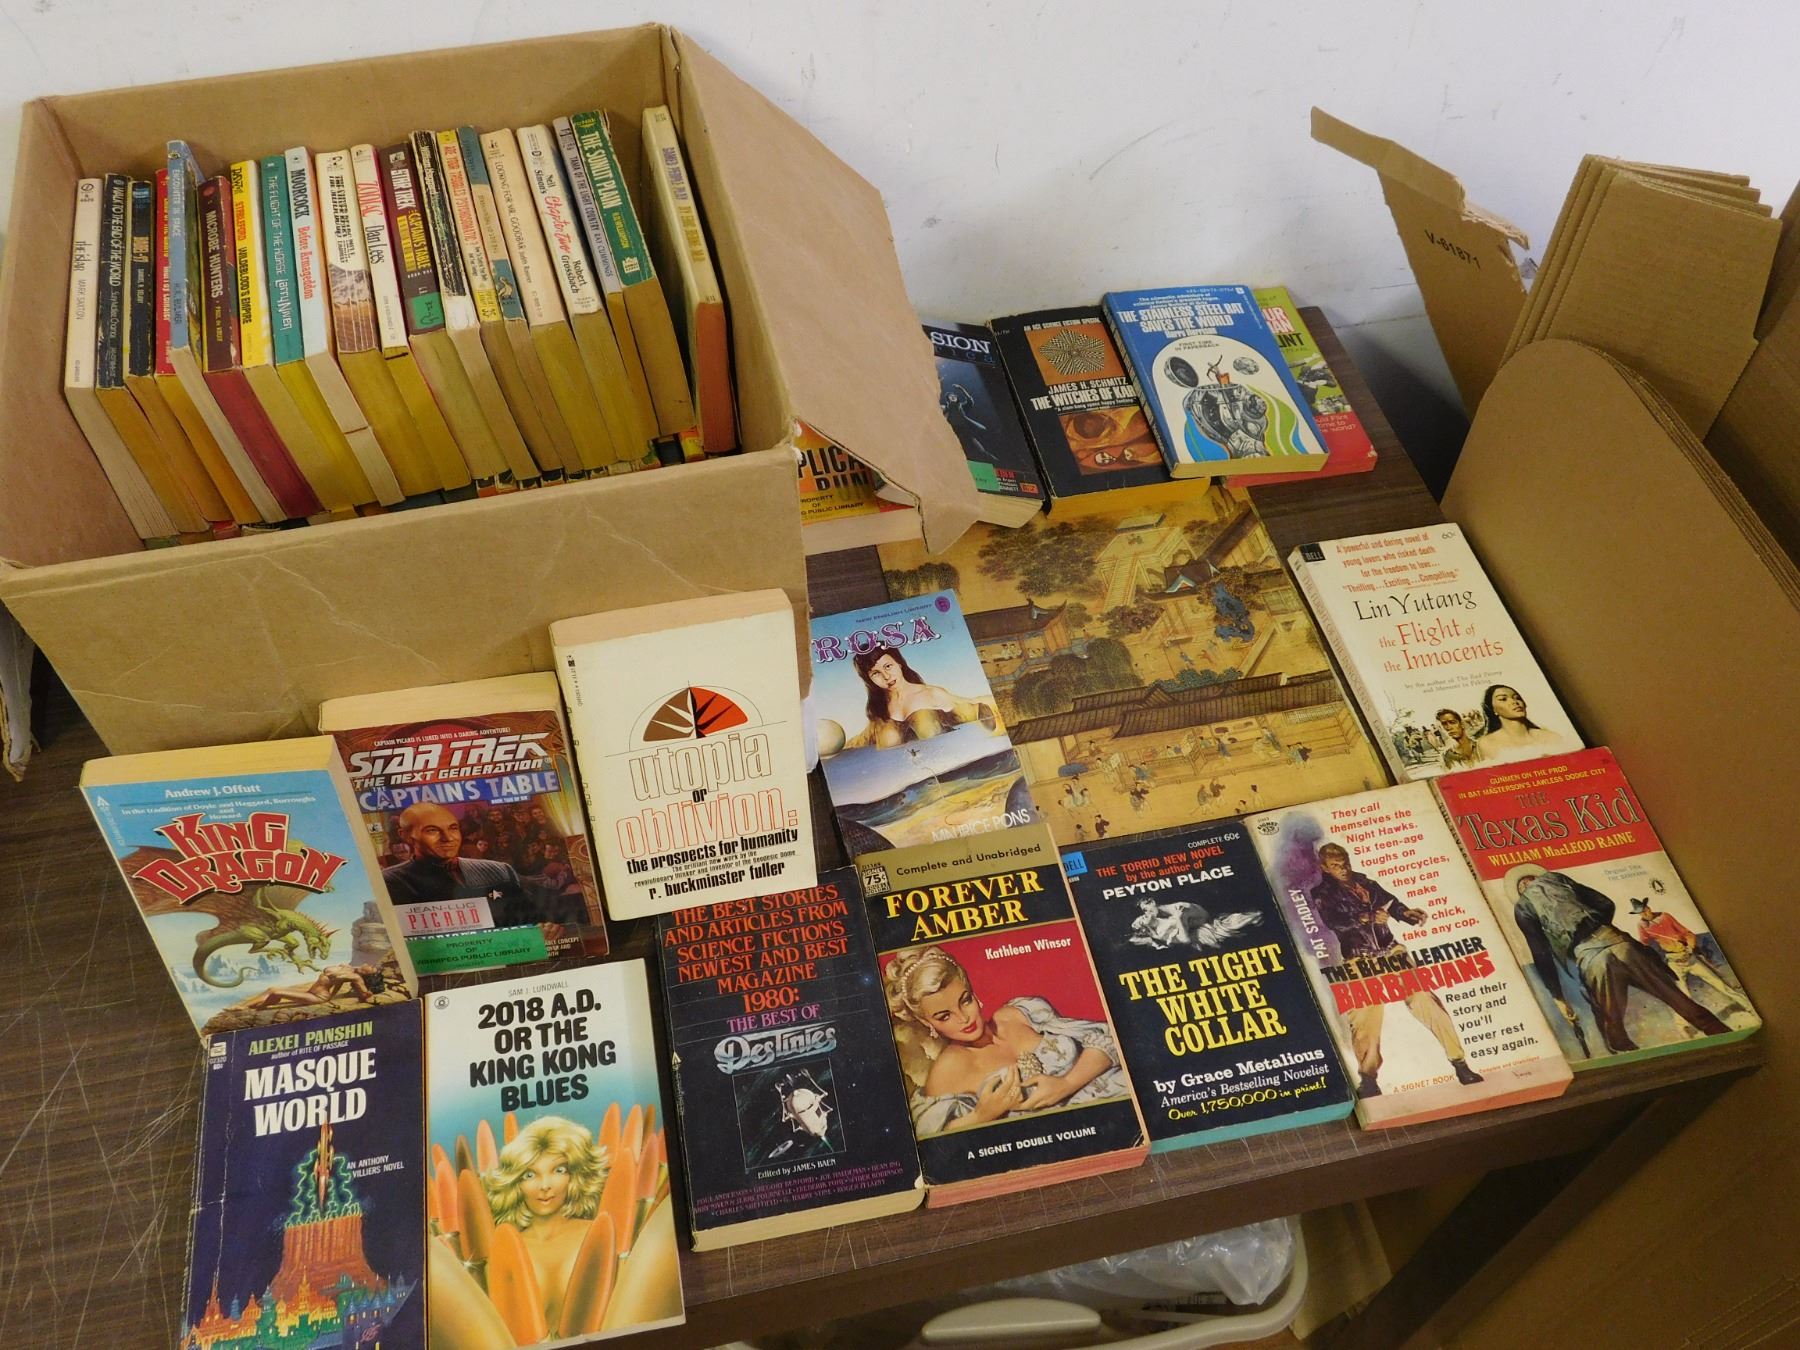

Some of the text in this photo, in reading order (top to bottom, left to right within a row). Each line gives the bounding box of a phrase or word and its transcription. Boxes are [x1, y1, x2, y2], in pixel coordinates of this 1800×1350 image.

[580, 130, 602, 151] THE
[585, 147, 613, 182] SUNLIT
[289, 168, 309, 218] MOORCOCK
[356, 180, 383, 218] ZODIAC
[595, 178, 622, 210] PLAIN
[267, 175, 285, 274] THE FLIGHT OF THE HORSE
[364, 224, 389, 264] Dan Lees
[204, 210, 222, 297] MICROBE HUNTERS
[297, 226, 315, 300] Before Armageddon
[572, 259, 587, 286] Robert
[560, 254, 580, 294] Grossbach
[1117, 303, 1244, 323] THE STAINLESS STEEL RAT
[1140, 315, 1234, 333] SAVES THE WORLD
[1030, 398, 1053, 411] THE
[1052, 390, 1099, 406] WITCHES
[1100, 388, 1114, 401] OF
[1048, 377, 1128, 395] JAMES H. SCHMITZ
[1353, 590, 1477, 621] Lin Yutang
[811, 616, 941, 664] ROSA
[1380, 618, 1476, 649] the Flight of
[1384, 639, 1504, 673] the Innocents
[350, 732, 550, 777] STAR TREK
[354, 759, 543, 788] THE NEXT GENERATION
[629, 733, 772, 802] utopia
[164, 783, 262, 799] Andrew J. Offutt
[358, 770, 559, 811] CAPTAIN'S TABLE
[692, 788, 708, 803] or
[616, 787, 799, 860] oblivion:
[932, 808, 1031, 842] MAURICE PONS
[1329, 808, 1412, 834] themselves the
[1331, 802, 1381, 821] They call
[1456, 787, 1643, 851] Texas Kid
[153, 812, 290, 859] KING
[627, 828, 798, 875] the prospects for humanity
[1346, 823, 1419, 844] Night Hawks.
[1488, 831, 1636, 868] WILLIAM MacLEOD RAINE
[131, 846, 349, 905] DRAGON
[896, 843, 1042, 877] Complete and Unabridged
[649, 861, 785, 900] r. buckminster fuller
[883, 870, 1044, 919] FOREVER
[1102, 865, 1235, 901] PEYTON PLACE
[407, 909, 480, 930] PICARD
[664, 901, 849, 948] AND ARTICLES FROM
[671, 884, 839, 927] THE BEST STORIES
[911, 899, 1029, 942] AMBER
[1288, 888, 1329, 961] PAT STADLEY
[677, 920, 846, 964] SCIENCE FICTION'S
[677, 937, 849, 983] NEWEST AND BEST
[985, 937, 1072, 961] Kathleen Winsor
[1320, 936, 1487, 984] THE BLACK LEATHER
[716, 962, 817, 995] MAGAZINE
[1118, 943, 1285, 1002] THE TIGHT
[1328, 949, 1496, 1016] BARBARIANS
[477, 989, 602, 1029] 2018 A.D.
[726, 1004, 820, 1033] THE BEST OF
[743, 986, 800, 1014] 1980:
[1156, 979, 1268, 1025] WHITE
[249, 1021, 373, 1056] ALEXEI PANSHIN
[494, 1016, 589, 1055] OR THE
[713, 1020, 838, 1075] Destinies
[1164, 1007, 1287, 1057] COLLAR
[244, 1047, 377, 1101] MASQUE
[470, 1040, 617, 1088] KING KONG
[1153, 1049, 1325, 1095] by Grace Metalious
[254, 1087, 367, 1137] WORLD
[500, 1074, 589, 1113] BLUES
[347, 1155, 389, 1169] AN ANTHONY
[967, 1126, 1097, 1160] A SIGNET DOUBLE VOLUME
[352, 1161, 404, 1179] VILLIERS NOVEL
[757, 1158, 837, 1180] Edited by JAMES BAEN
